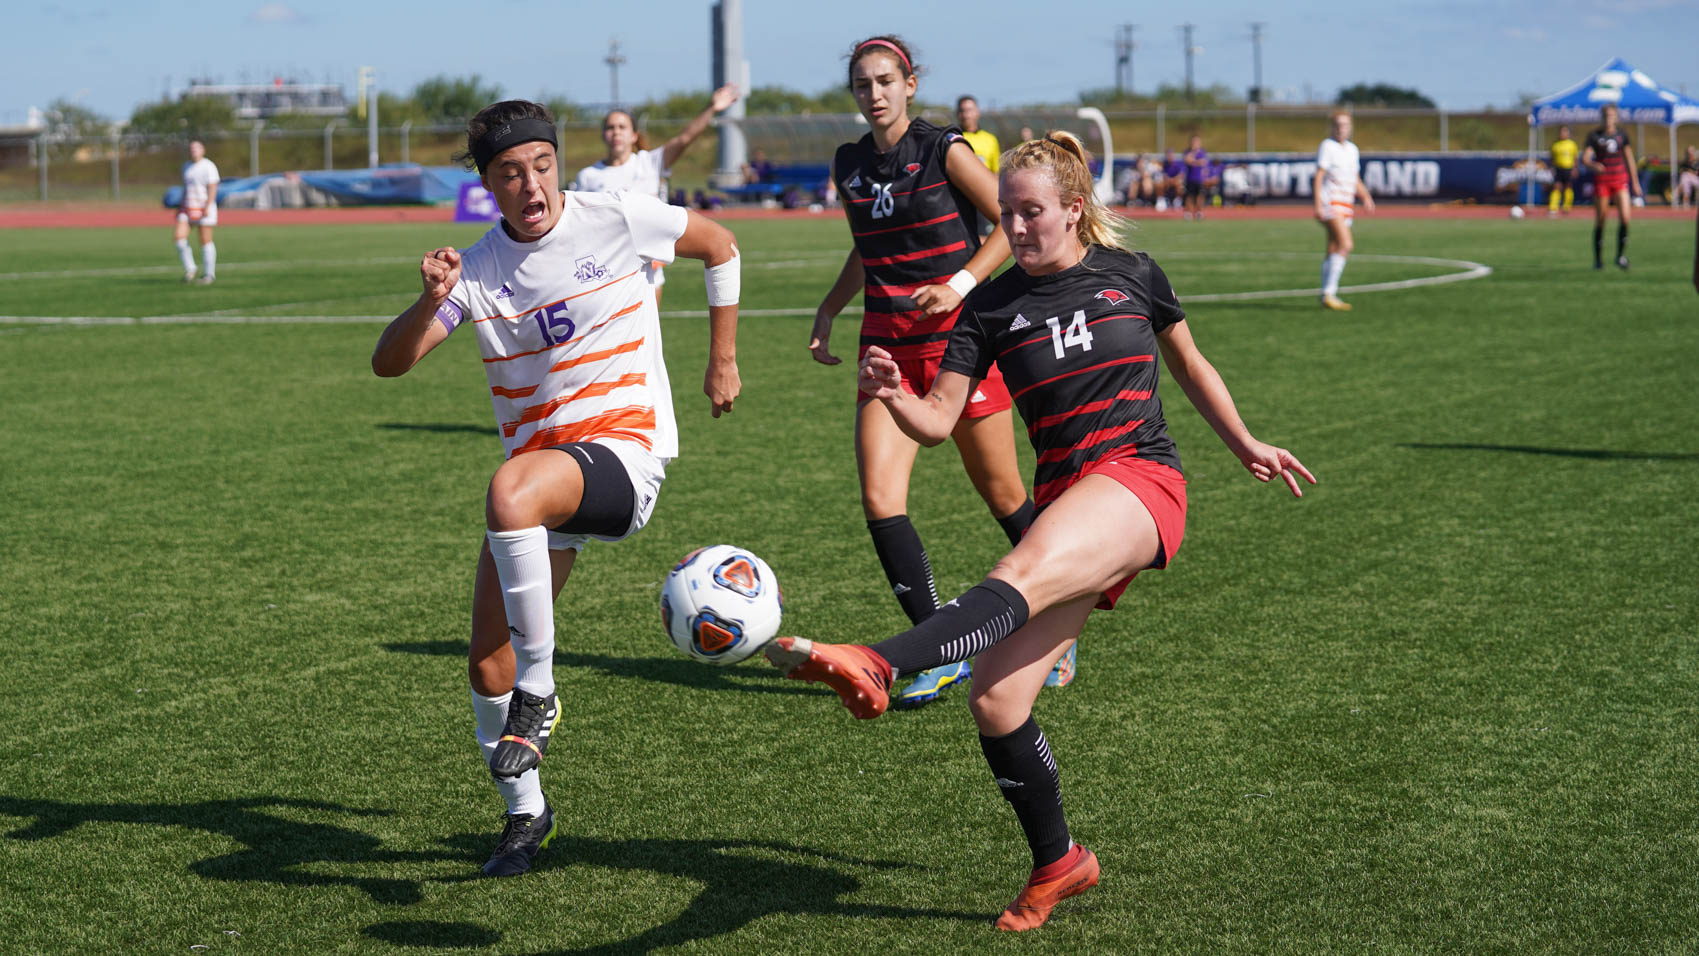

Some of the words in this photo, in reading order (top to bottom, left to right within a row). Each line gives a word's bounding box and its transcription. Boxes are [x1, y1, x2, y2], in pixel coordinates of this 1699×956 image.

[871, 183, 895, 220] 26
[534, 301, 576, 347] 15
[1046, 310, 1093, 359] 14
